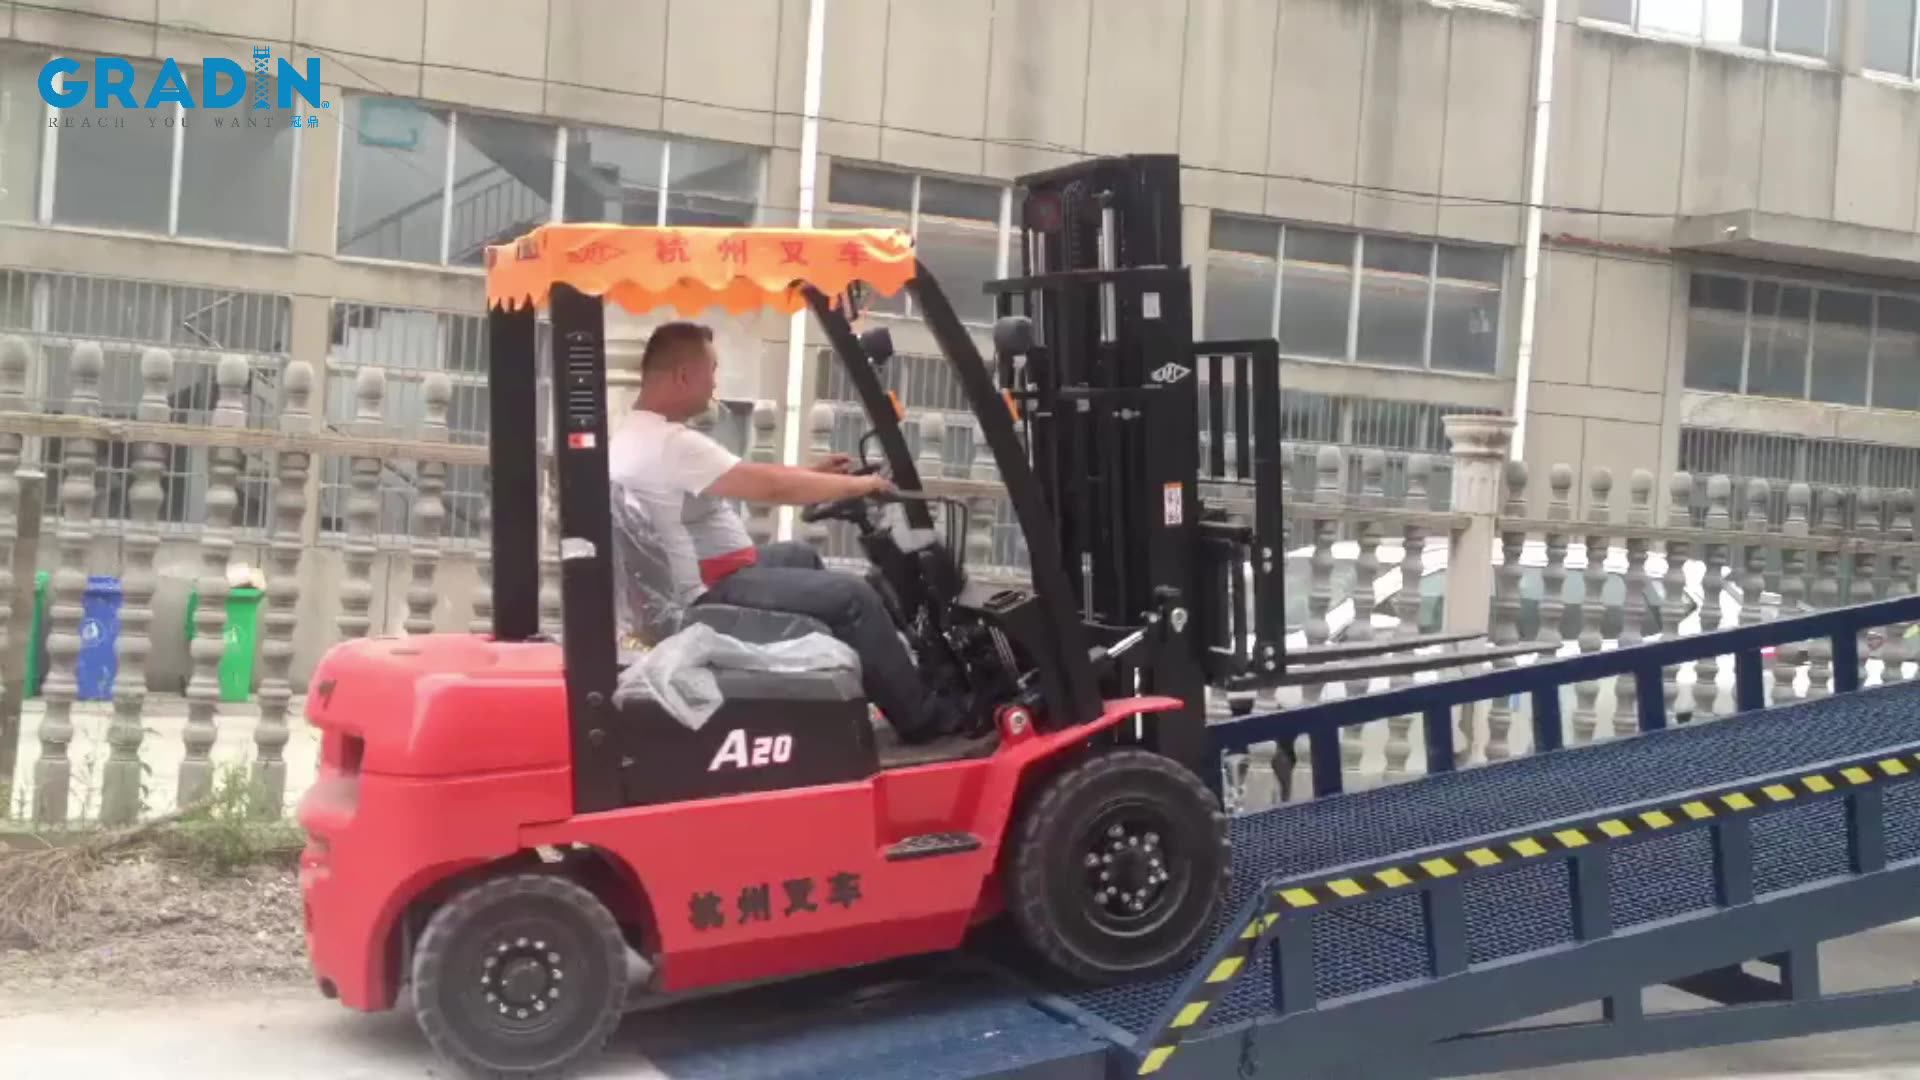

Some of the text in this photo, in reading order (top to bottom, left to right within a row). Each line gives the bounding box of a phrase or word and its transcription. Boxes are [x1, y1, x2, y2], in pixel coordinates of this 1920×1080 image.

[655, 239, 869, 267] 杭州叉车
[707, 728, 793, 772] A20
[688, 871, 863, 931] 杭州叉车
